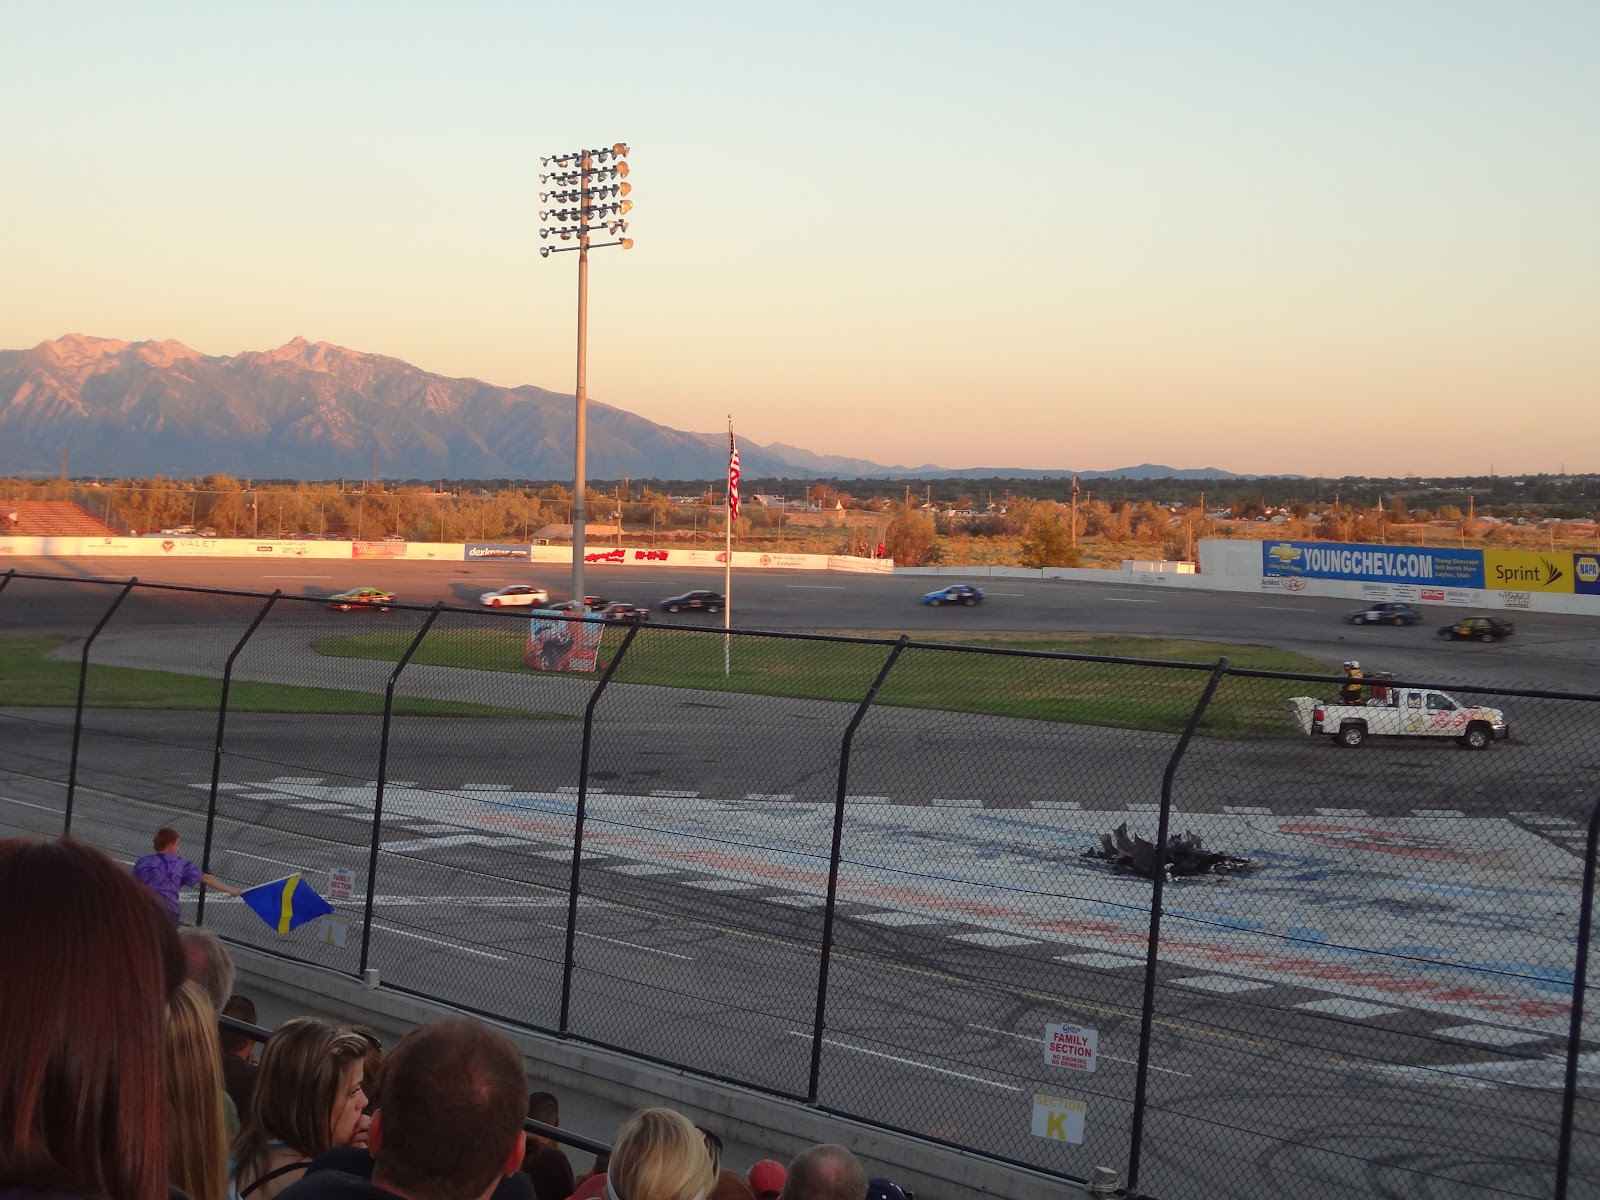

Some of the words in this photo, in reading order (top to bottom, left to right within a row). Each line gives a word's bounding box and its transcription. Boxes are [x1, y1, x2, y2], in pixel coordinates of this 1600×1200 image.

[179, 540, 217, 548] VALET
[1303, 548, 1433, 578] YOUNGCHEV.COM
[1580, 563, 1597, 575] NAPA
[1496, 564, 1540, 583] Sprint
[1422, 590, 1444, 598] GMC
[1406, 713, 1423, 732] 2
[333, 873, 351, 882] FAMILY
[331, 881, 352, 891] SECTION
[1053, 1032, 1089, 1046] FAMILY
[1049, 1042, 1092, 1058] SECTION
[1060, 1060, 1088, 1070] DRINKING
[1062, 1056, 1087, 1064] SMOKING
[1035, 1095, 1085, 1112] SECTION
[1046, 1111, 1068, 1140] K
